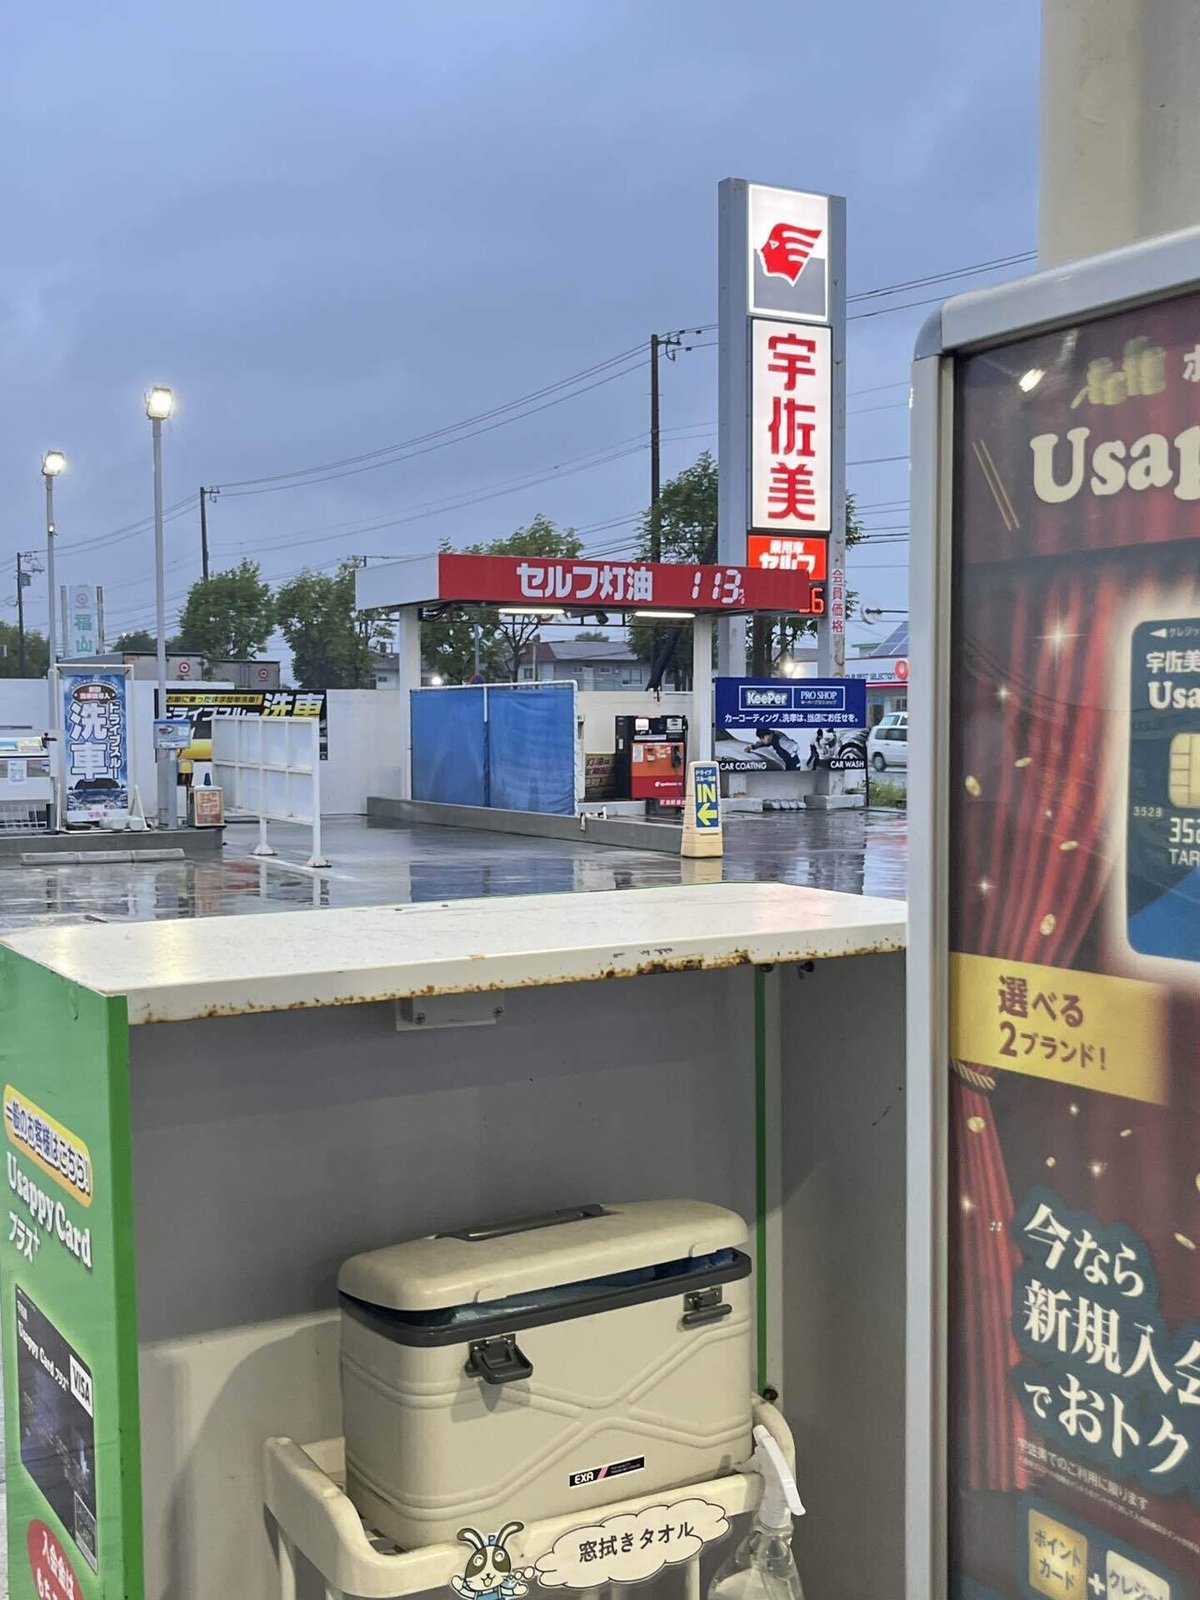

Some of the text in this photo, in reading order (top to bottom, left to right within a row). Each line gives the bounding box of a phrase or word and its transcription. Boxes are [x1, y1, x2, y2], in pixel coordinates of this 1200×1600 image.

[767, 332, 817, 522] 宇佐美
[516, 562, 653, 601] セルフ灯油
[691, 569, 742, 604] 113
[74, 614, 92, 652] 福山
[262, 693, 325, 717] 洗車
[745, 690, 788, 705] KeePer
[800, 691, 838, 700] PRO SHOP
[70, 702, 108, 780] 洗車
[108, 702, 122, 779] ドライブスルー
[720, 761, 767, 770] CAR COATING
[830, 760, 865, 769] CAR WASH
[697, 783, 717, 803] IN
[1168, 817, 1200, 844] 35
[998, 974, 1084, 1029] 選べる
[7, 1151, 92, 1269] Usappy Card
[1024, 1203, 1145, 1298] 今なら
[72, 1362, 91, 1402] VISA
[1023, 1373, 1189, 1473] でおトク
[574, 1471, 595, 1486] EXA
[579, 1521, 695, 1563] 窓拭きタオル
[1034, 1529, 1081, 1567] ポイント
[1039, 1558, 1075, 1591] カード
